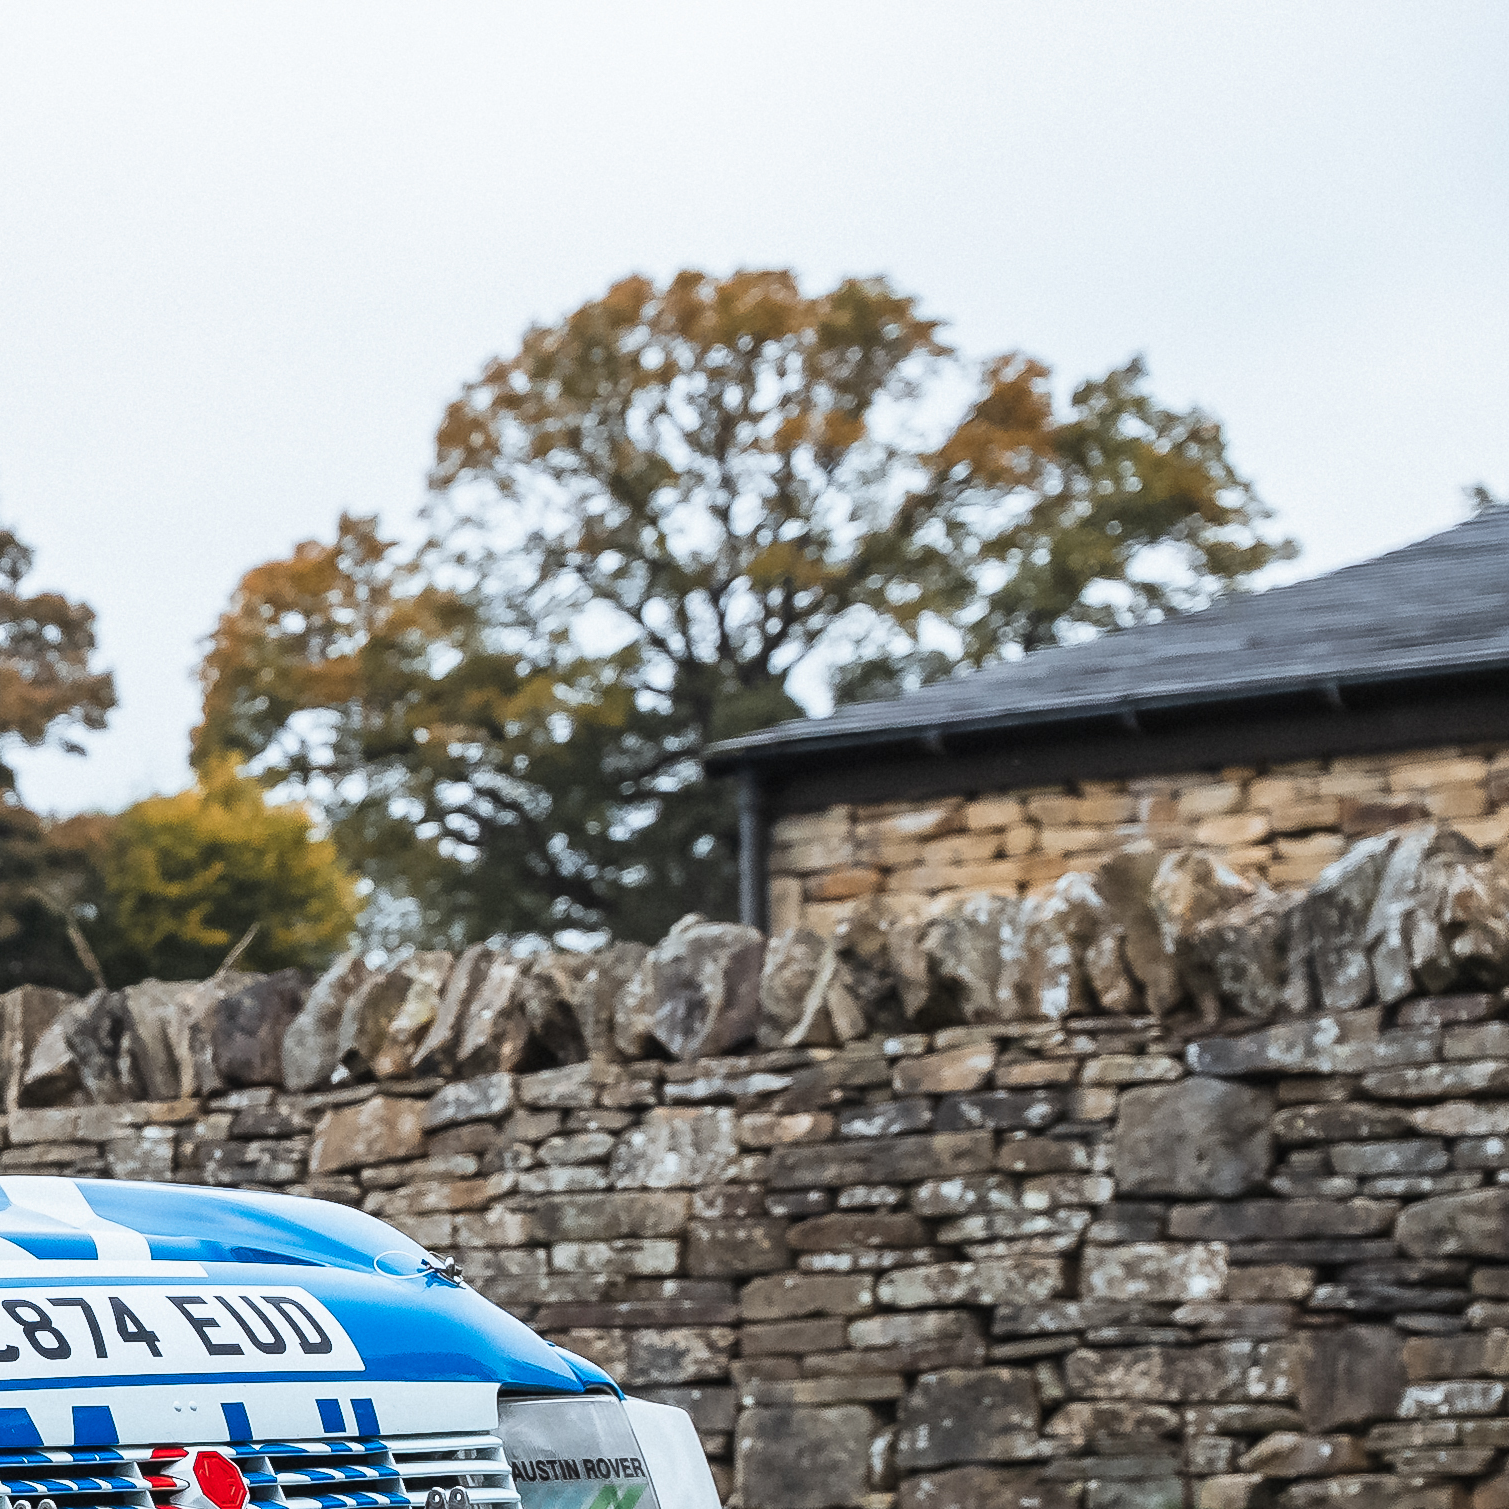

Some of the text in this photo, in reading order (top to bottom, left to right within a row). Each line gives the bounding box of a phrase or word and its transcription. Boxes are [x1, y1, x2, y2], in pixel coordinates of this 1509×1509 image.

[180, 1294, 335, 1355] EUD
[511, 1457, 646, 1482] AUSTIN ROVER
